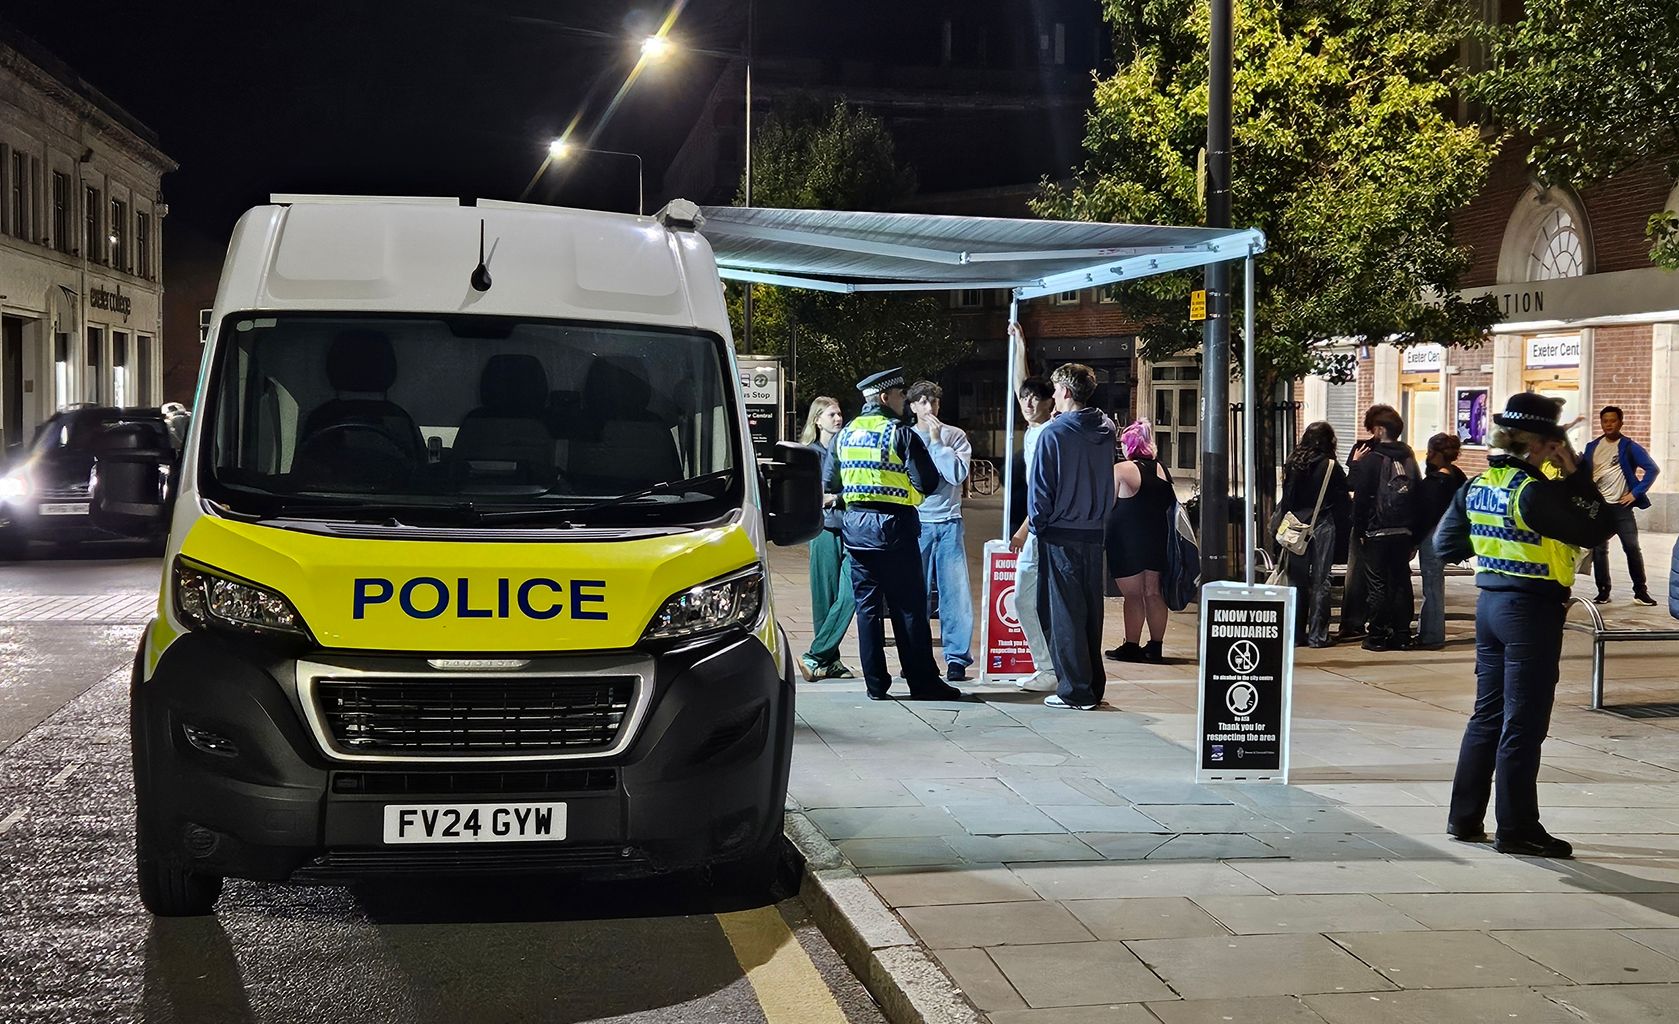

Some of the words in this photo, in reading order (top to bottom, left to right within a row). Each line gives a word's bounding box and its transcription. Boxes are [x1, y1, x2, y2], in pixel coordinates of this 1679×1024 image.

[110, 284, 131, 323] college
[1533, 343, 1558, 358] Exeter
[1560, 341, 1580, 357] Cent
[1407, 351, 1427, 363] Exeter
[752, 391, 771, 400] Stop
[844, 433, 878, 448] POLICE
[1467, 487, 1506, 513] POLICE
[353, 577, 609, 621] POLICE
[1214, 609, 1248, 622] KNOW
[1249, 610, 1277, 623] YOUR
[1211, 625, 1278, 638] BOUNDARIES
[1218, 722, 1240, 731] Thank
[1241, 723, 1254, 732] you
[1255, 723, 1266, 731] for
[1206, 733, 1246, 742] respecting
[1246, 733, 1259, 741] the
[1259, 734, 1276, 742] area
[398, 809, 482, 838] FV24
[492, 807, 553, 837] GYW
